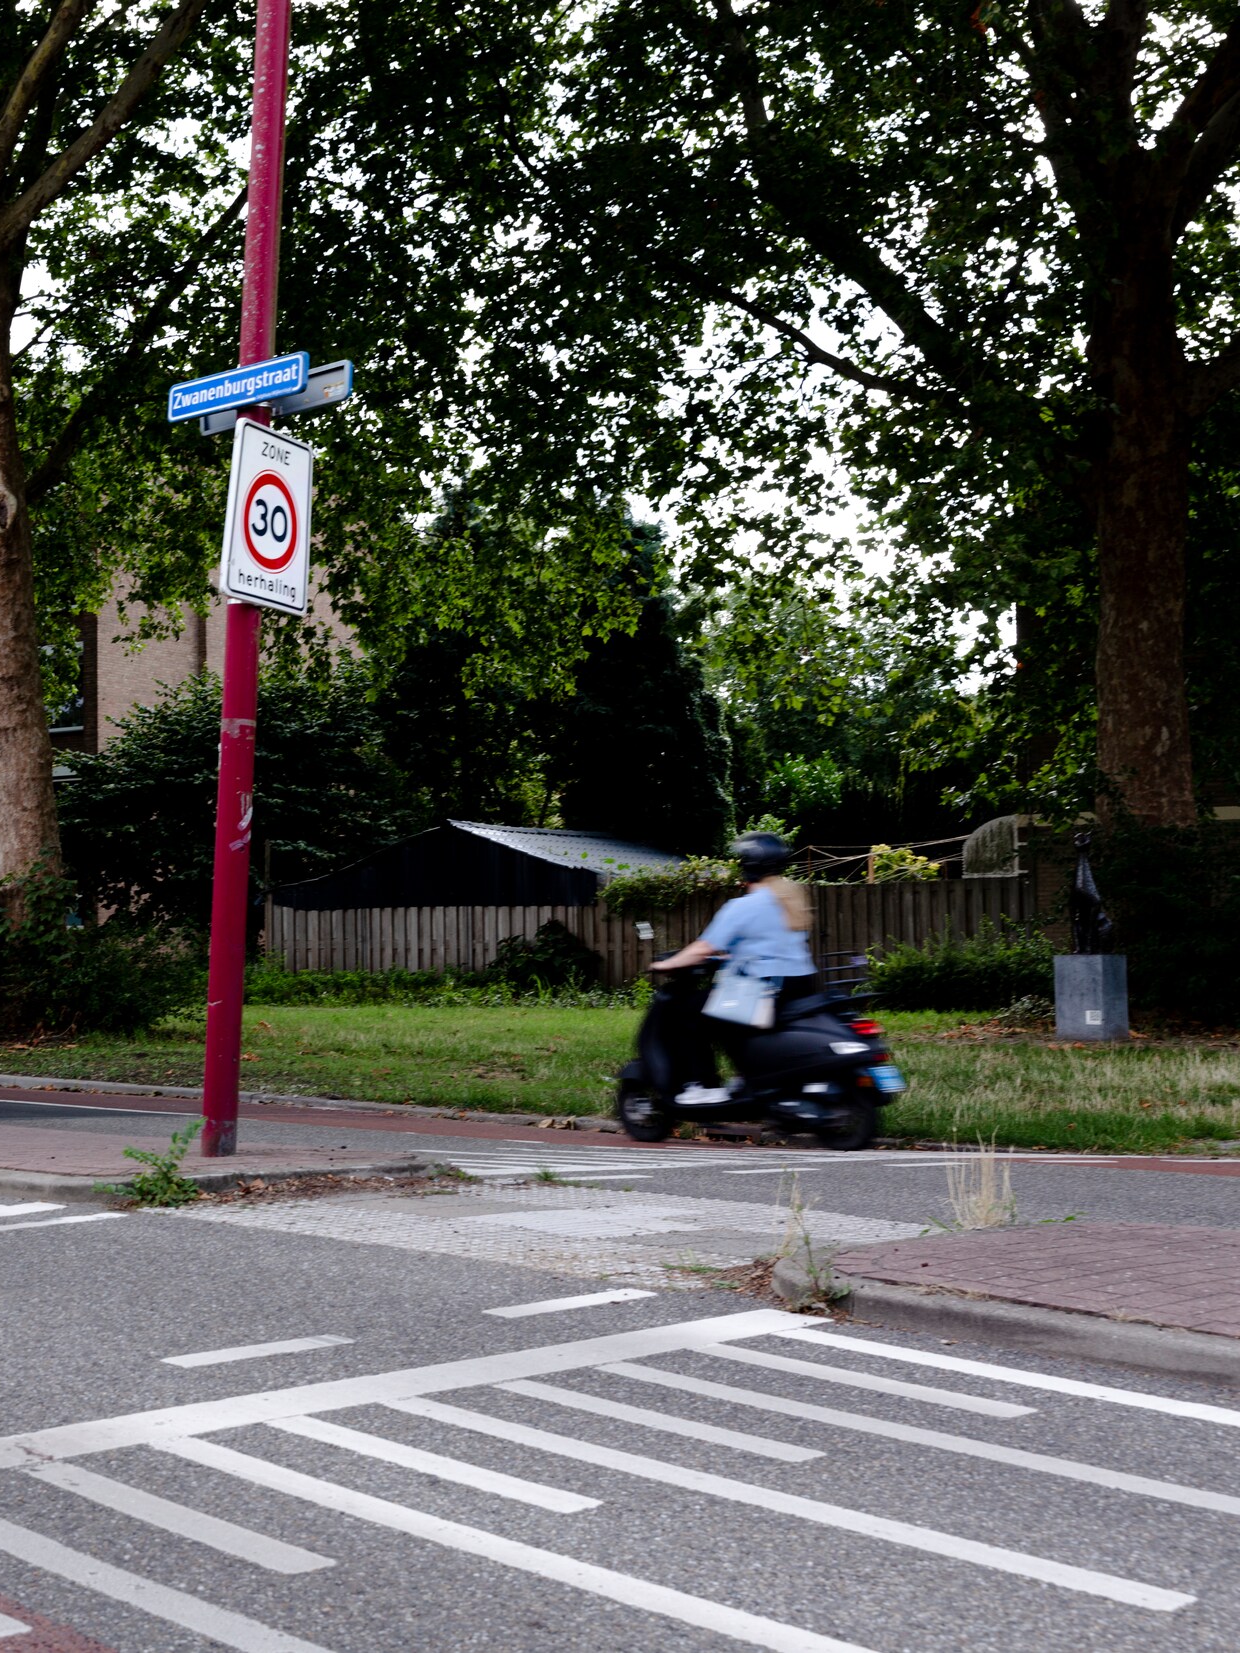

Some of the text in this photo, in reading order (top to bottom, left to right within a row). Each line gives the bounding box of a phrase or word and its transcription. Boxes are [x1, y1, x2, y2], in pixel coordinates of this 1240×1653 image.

[173, 363, 298, 410] Zwanenburgstraat
[261, 442, 291, 466] ZONE
[252, 498, 288, 543] 30
[238, 569, 297, 602] herhaling
